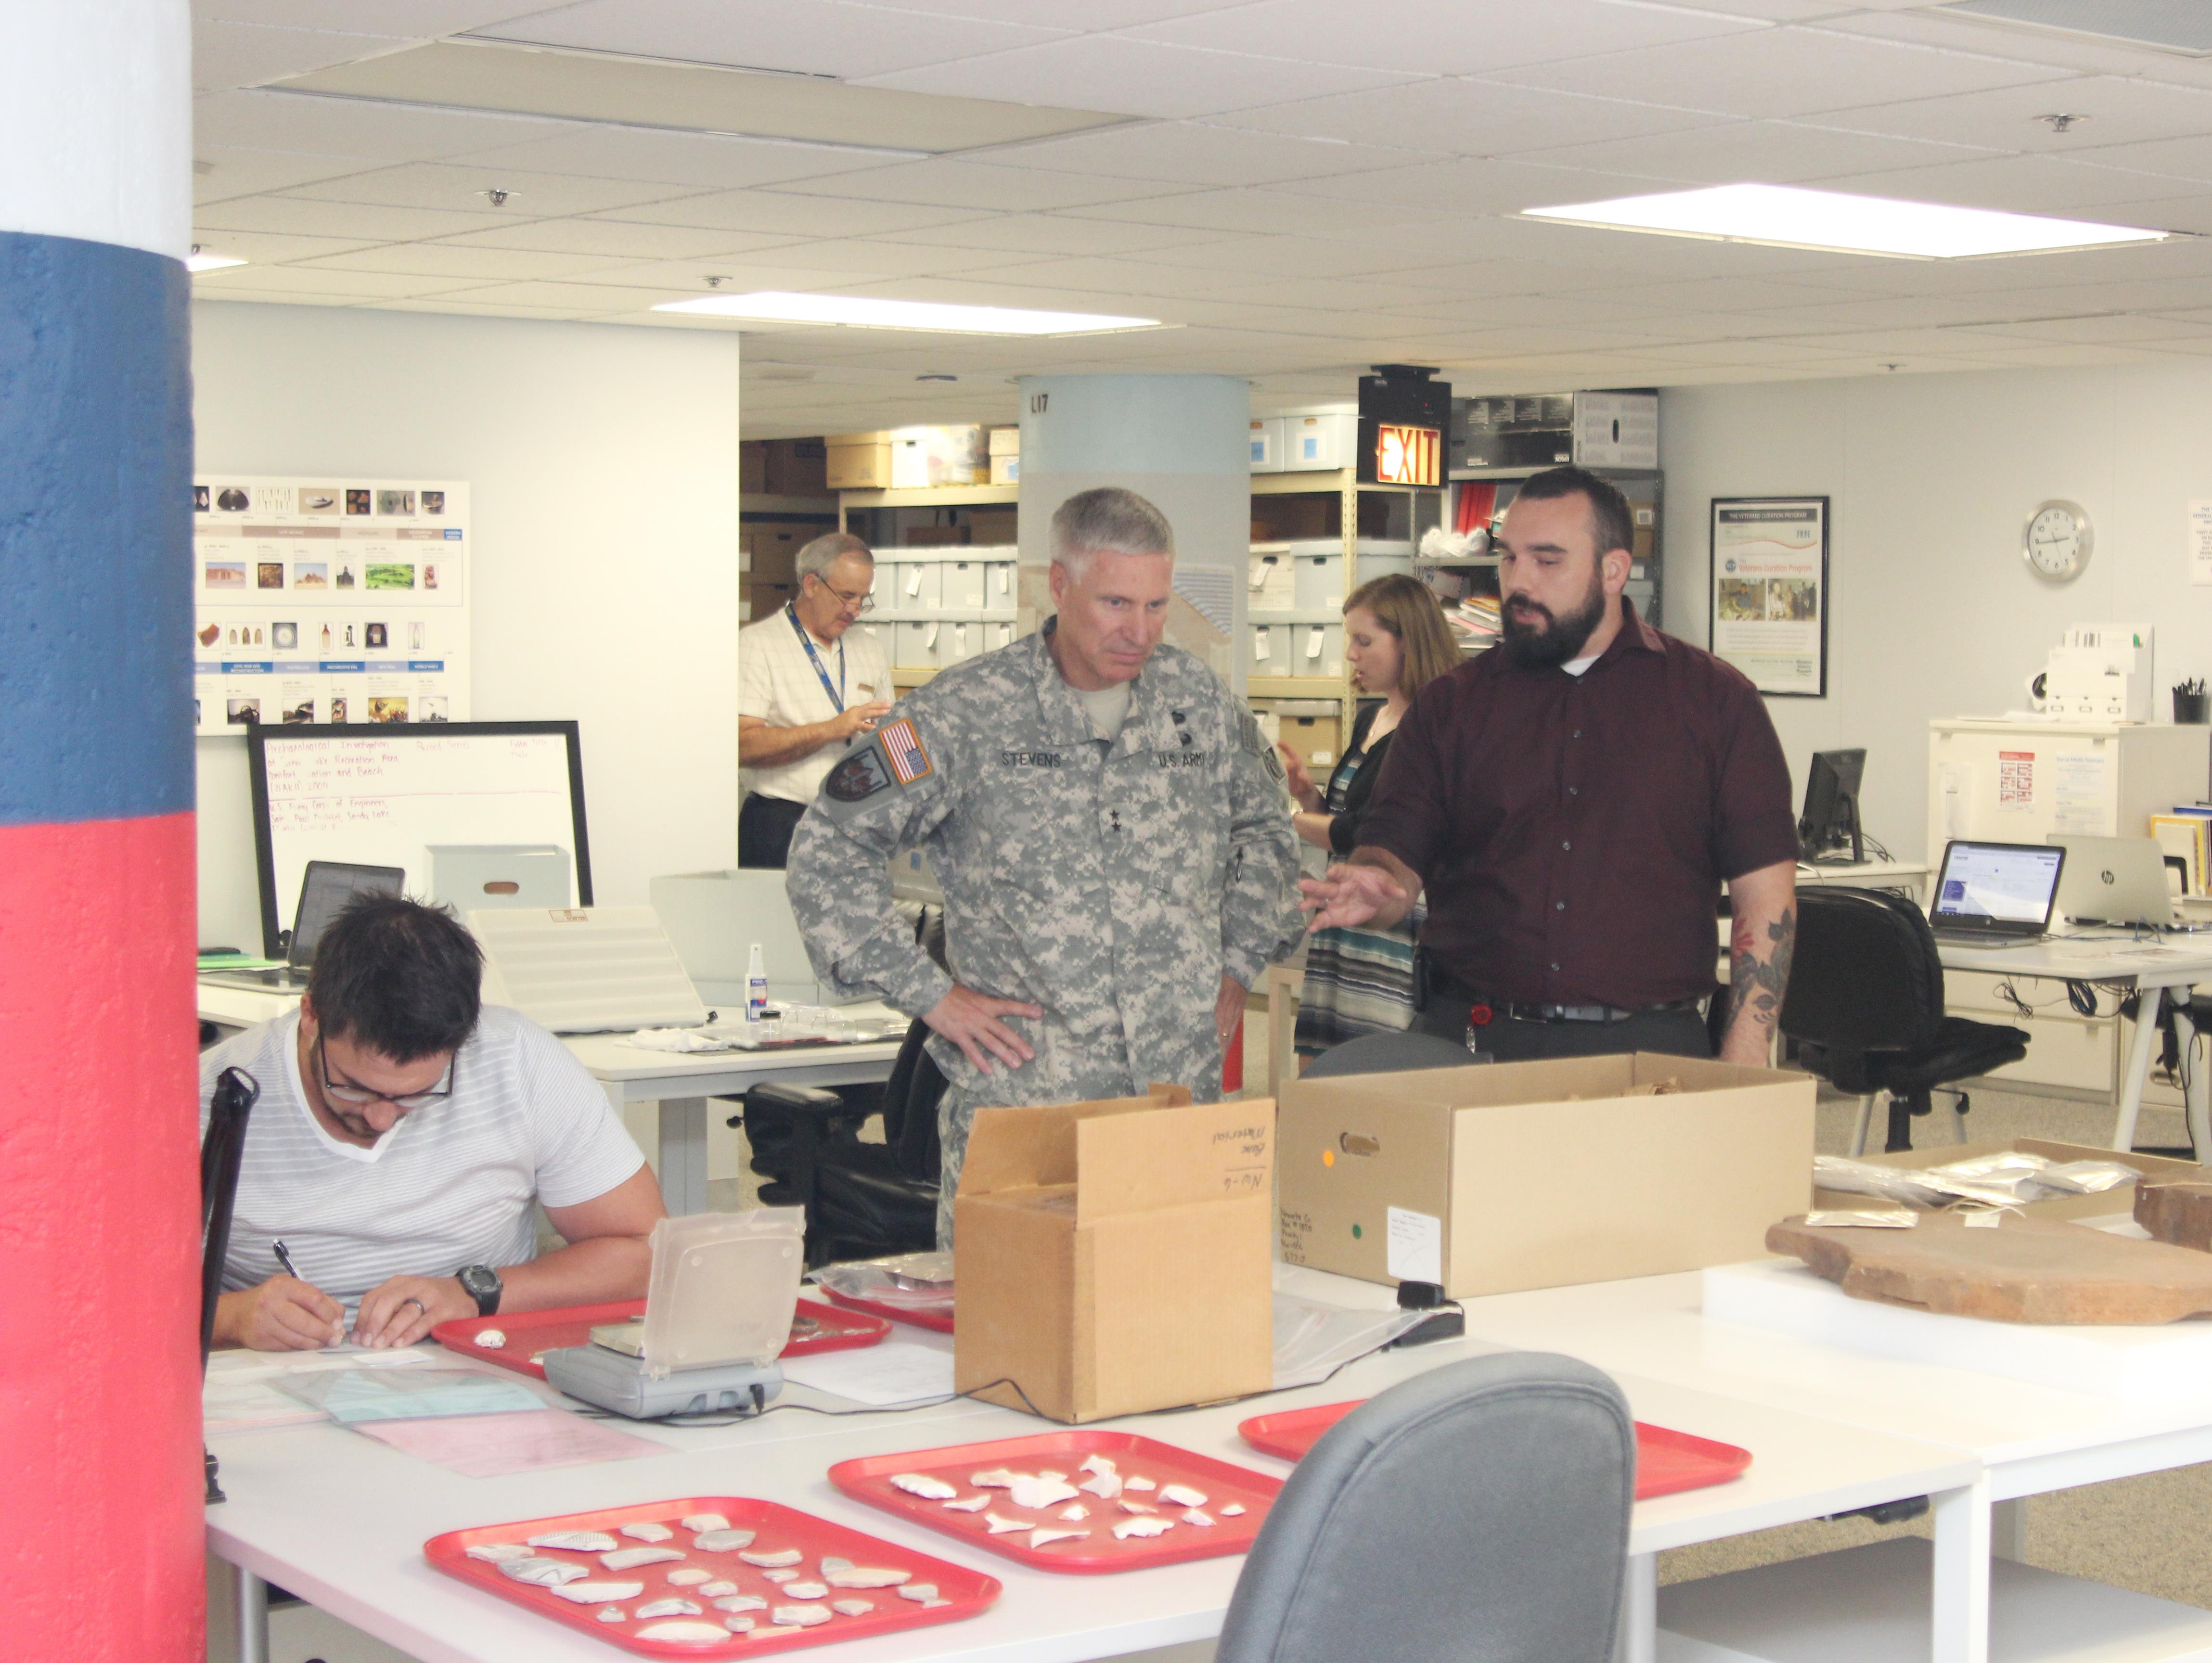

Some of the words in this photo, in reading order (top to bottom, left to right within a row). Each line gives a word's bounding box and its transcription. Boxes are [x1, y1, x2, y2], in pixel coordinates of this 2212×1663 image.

[1031, 394, 1049, 414] L17
[1379, 427, 1439, 485] EXIT
[1739, 564, 1762, 573] Veterans
[1789, 564, 1813, 574] Program
[1002, 752, 1061, 768] STEVENS
[1158, 754, 1180, 768] U.S.
[1183, 752, 1205, 767] ARMY
[337, 768, 352, 777] and
